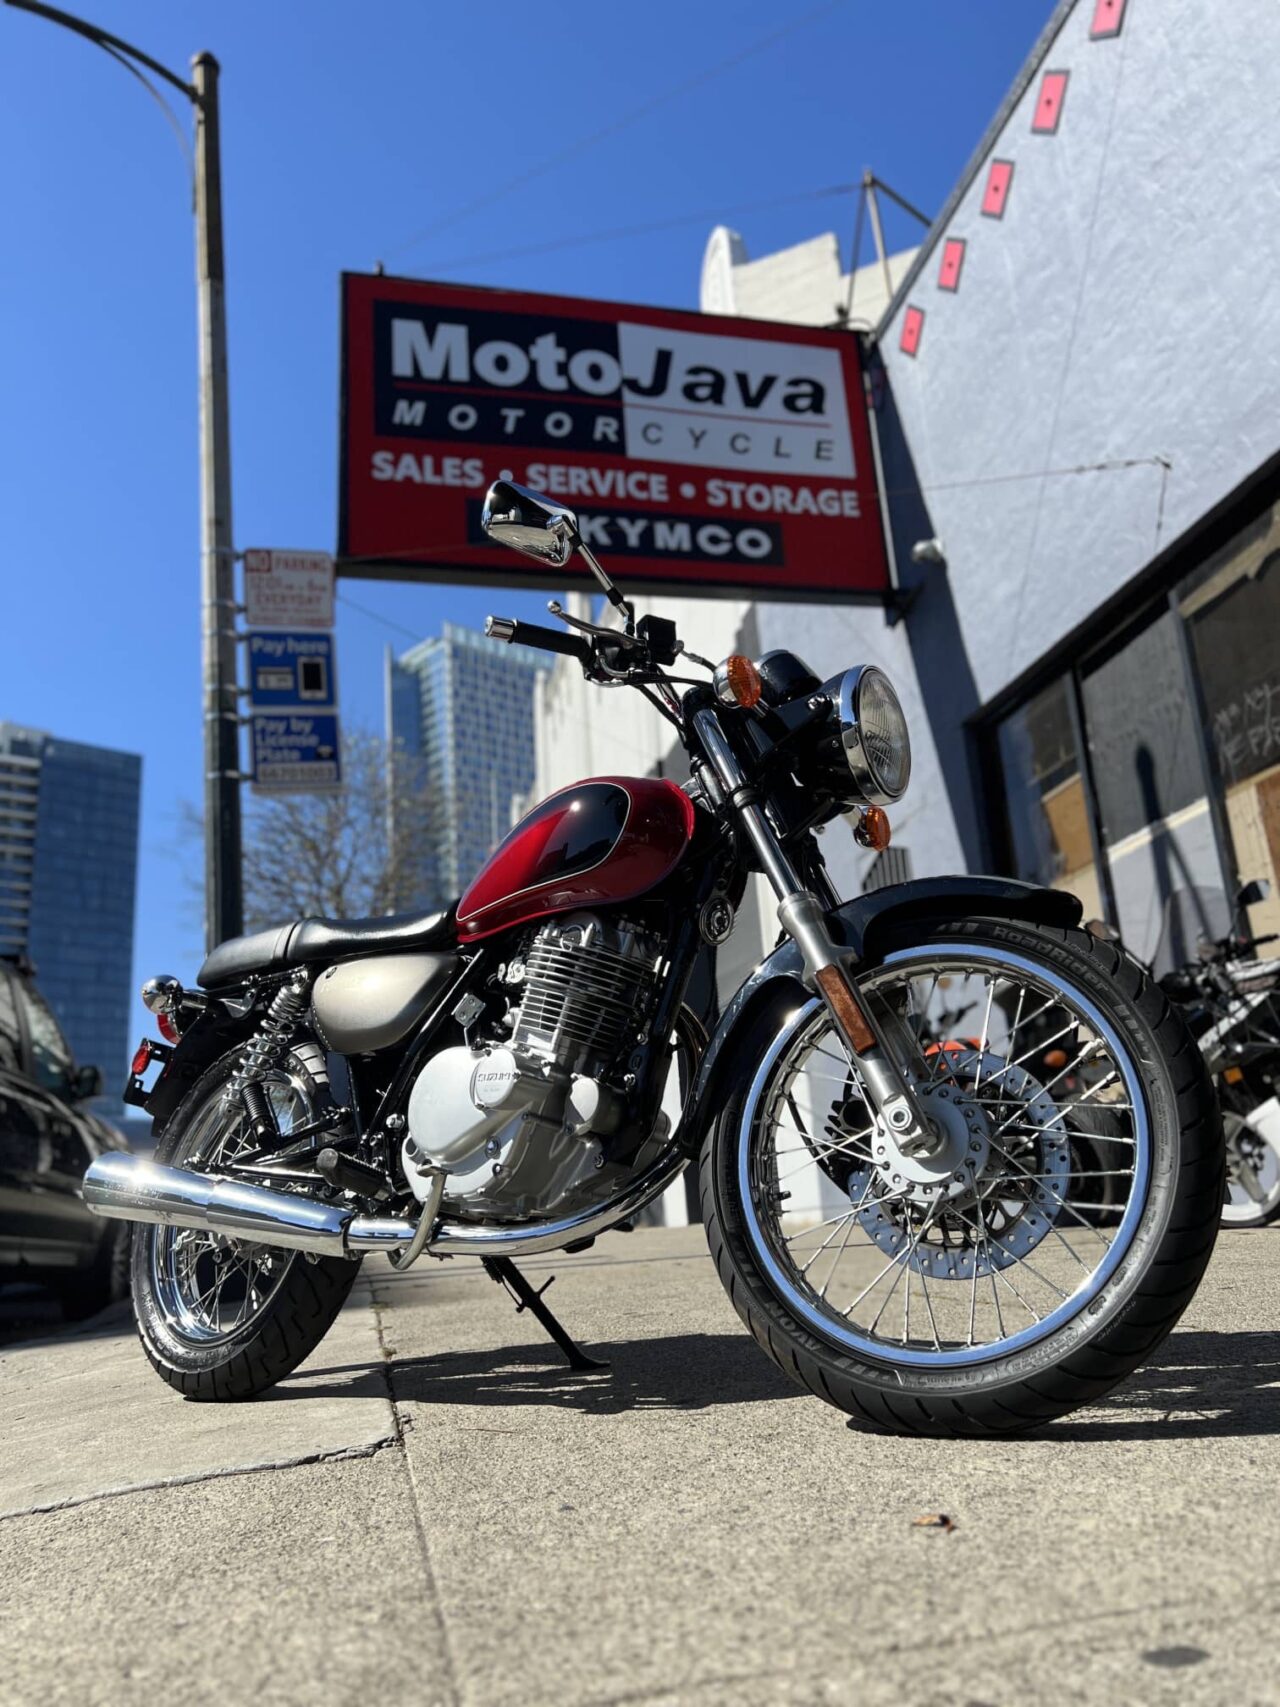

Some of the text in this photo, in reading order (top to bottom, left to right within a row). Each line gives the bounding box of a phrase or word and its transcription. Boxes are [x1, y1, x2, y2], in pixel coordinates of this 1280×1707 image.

[371, 450, 861, 518] SALES SERVICE STORAGE
[575, 514, 773, 559] KYMCO
[252, 637, 328, 657] Pay here
[255, 716, 314, 734] Pay by
[256, 732, 319, 748] License
[256, 747, 301, 761] Plate
[992, 926, 1110, 992] RoadRider
[764, 1301, 822, 1351] AVON
